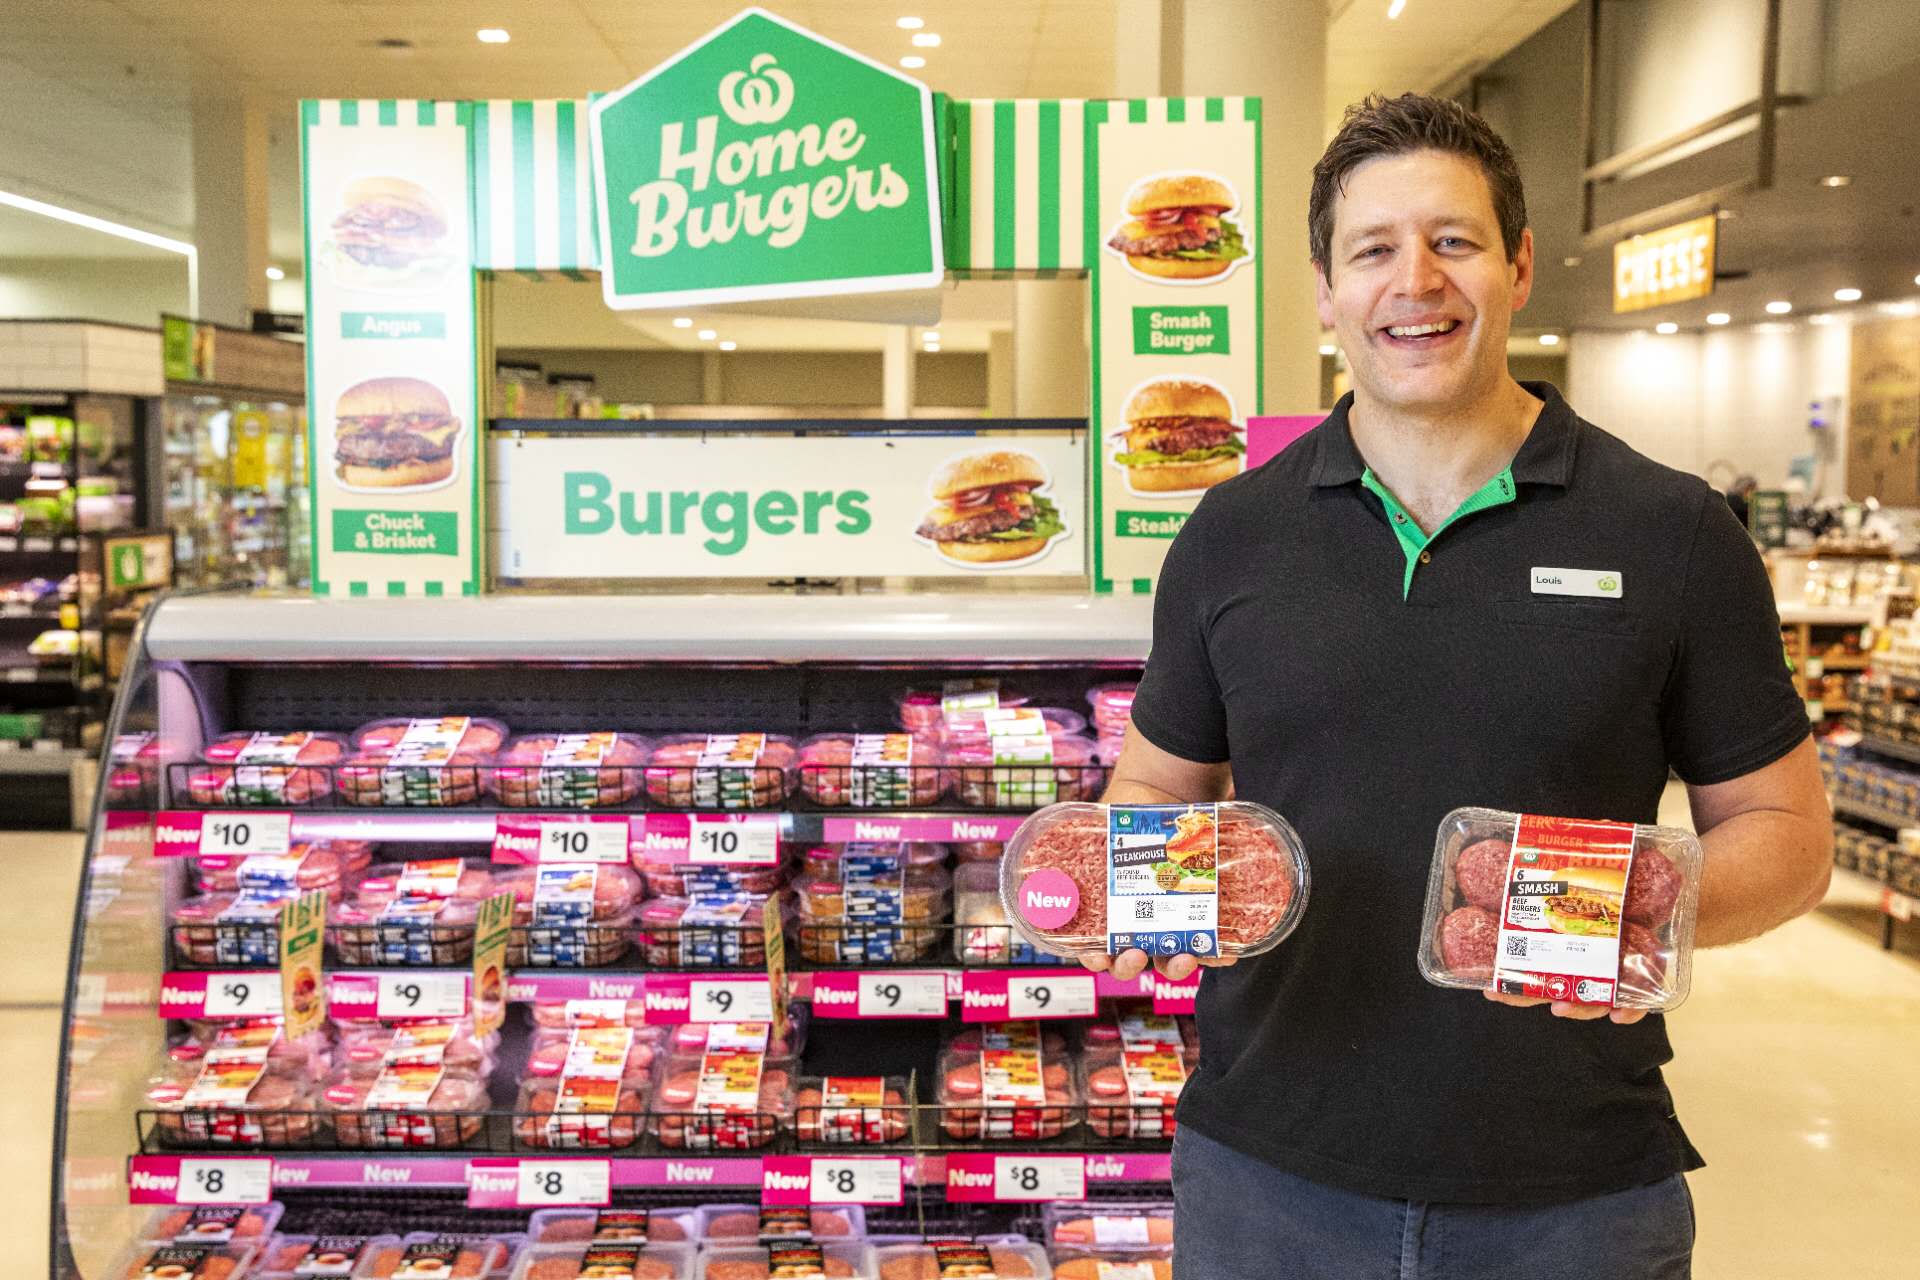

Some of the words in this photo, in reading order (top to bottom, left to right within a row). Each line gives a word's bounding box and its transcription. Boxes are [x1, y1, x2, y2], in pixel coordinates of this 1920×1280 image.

[658, 115, 866, 191] Home
[629, 163, 910, 257] Burgers
[1617, 235, 1708, 299] CHEESE
[361, 316, 422, 337] Angus
[1150, 312, 1212, 330] Smash
[1150, 331, 1214, 351] Burger
[364, 513, 425, 531] Chuck
[563, 471, 872, 556] Burgers
[355, 532, 368, 549] &
[371, 532, 436, 549] Brisket
[1536, 575, 1562, 585] Louis
[156, 826, 200, 843] New
[213, 823, 250, 845] $10
[855, 821, 901, 839] New
[951, 821, 998, 839] New
[495, 833, 539, 850] New
[552, 831, 588, 853] $10
[646, 832, 689, 849] New
[701, 831, 738, 853] $10
[1116, 837, 1123, 847] 4
[1537, 833, 1584, 848] BURGER
[1113, 848, 1166, 863] STEAKHOUSE
[1517, 870, 1524, 880] 6
[1518, 883, 1559, 895] SMASH
[1026, 891, 1071, 909] New
[1511, 904, 1541, 912] BURGERS
[160, 987, 205, 1005] New
[223, 983, 249, 1006] $9
[332, 986, 377, 1004] New
[394, 984, 421, 1007] $9
[507, 984, 538, 997] ew
[589, 981, 635, 998] New
[814, 986, 857, 1004] New
[874, 984, 901, 1007] $9
[964, 990, 1007, 1008] New
[1024, 986, 1051, 1008] $9
[1156, 983, 1199, 1000] New
[645, 992, 688, 1010] New
[706, 990, 733, 1013] $9
[132, 1172, 177, 1190] New
[195, 1169, 223, 1193] $8
[364, 1164, 411, 1182] New
[666, 1163, 714, 1182] New
[764, 1170, 810, 1190] New
[827, 1169, 855, 1193] $8
[949, 1168, 993, 1187] New
[1011, 1166, 1039, 1190] $8
[472, 1174, 516, 1191] New
[535, 1171, 562, 1195] $8
